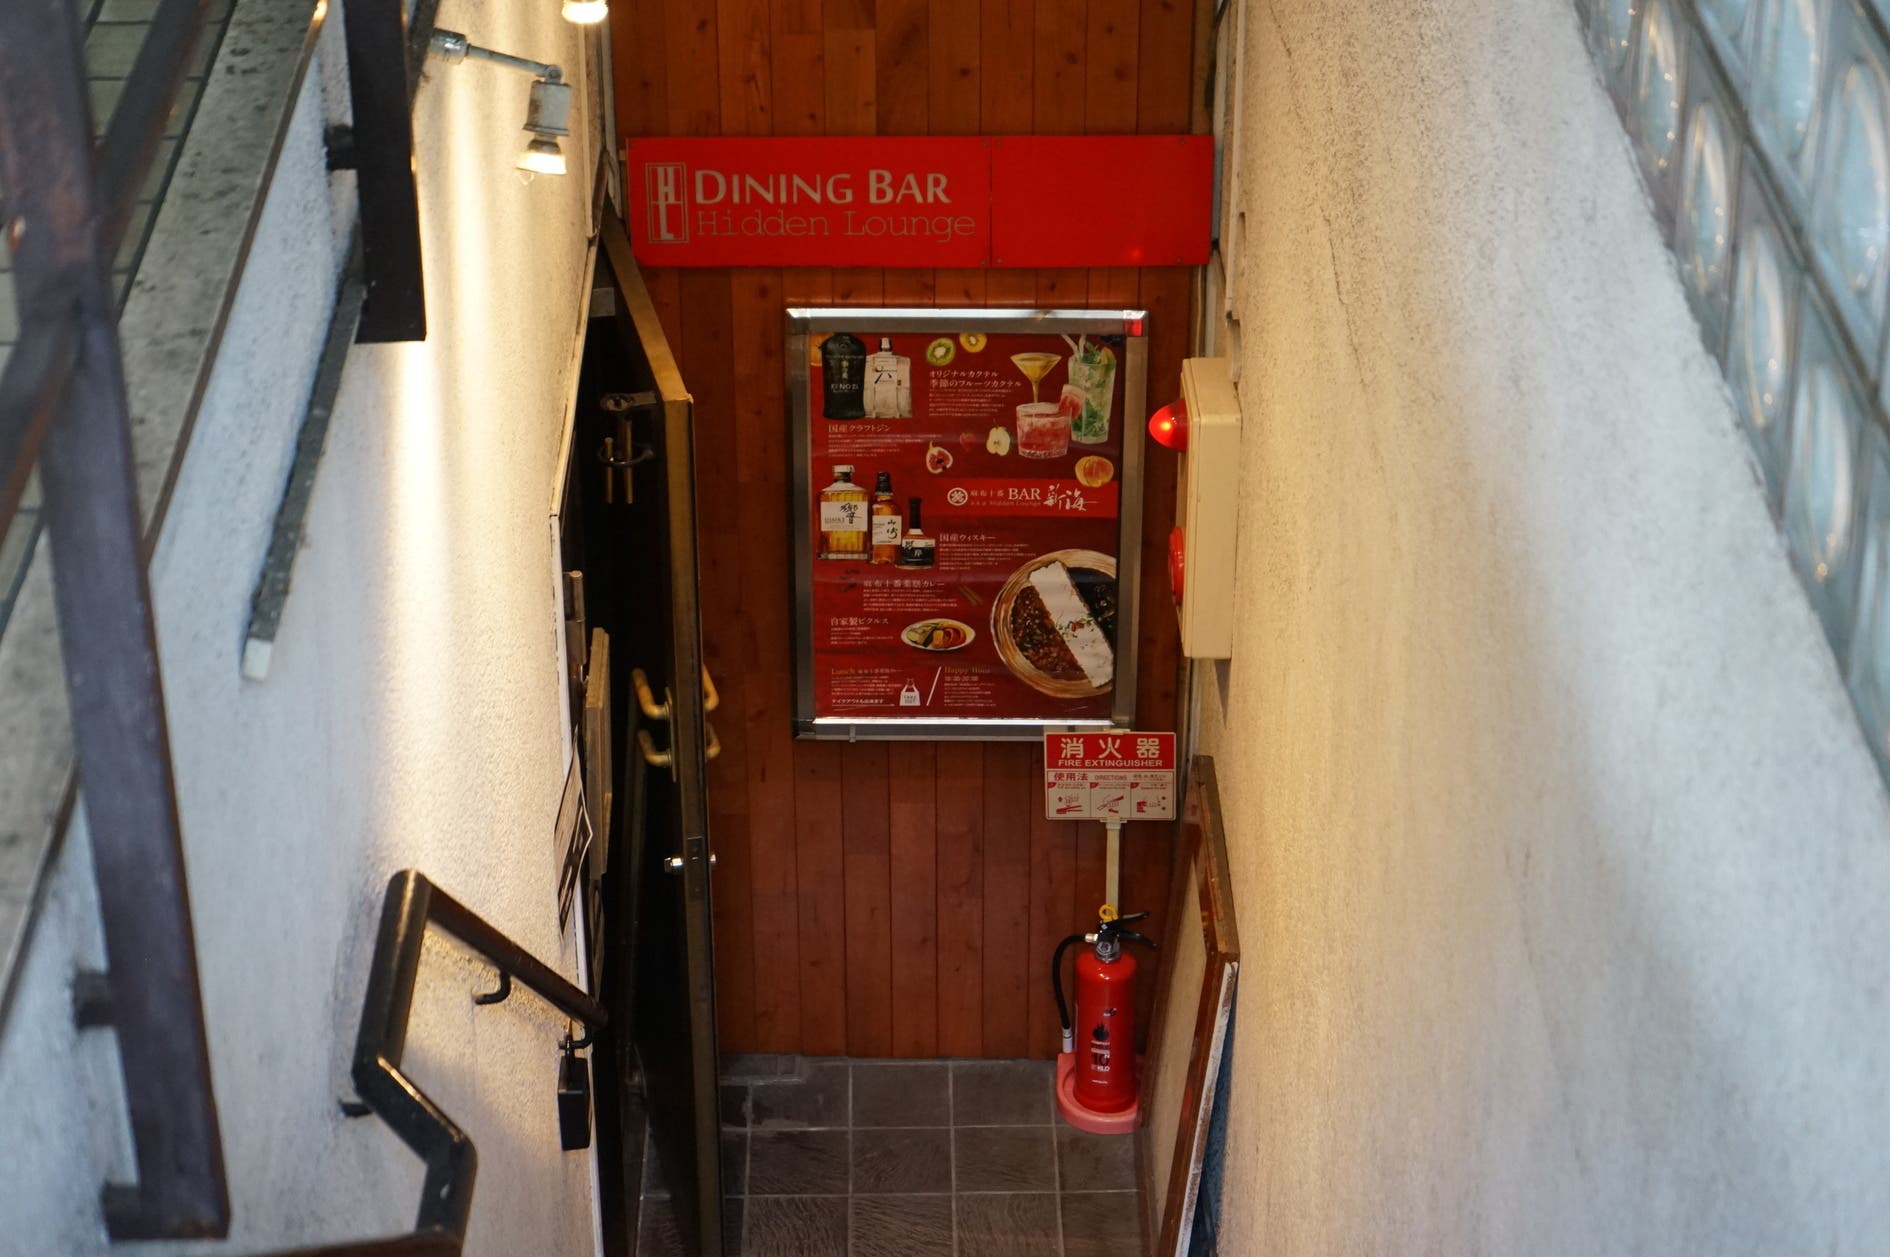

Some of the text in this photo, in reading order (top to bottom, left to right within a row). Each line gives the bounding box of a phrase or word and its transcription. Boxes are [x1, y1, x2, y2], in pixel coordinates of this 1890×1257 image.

[694, 168, 953, 205] DINING BAR
[696, 209, 977, 244] Hidden Lounge
[929, 370, 999, 378] オリジナルカクテル
[929, 379, 1022, 388] 季節のフルーツカクテル
[828, 424, 890, 433] 国産クラフトジン
[1008, 487, 1041, 500] BAR
[1060, 736, 1160, 759] 消火器
[1058, 759, 1163, 768] FIRE EXTINGUISHER
[1053, 772, 1089, 781] 使用法
